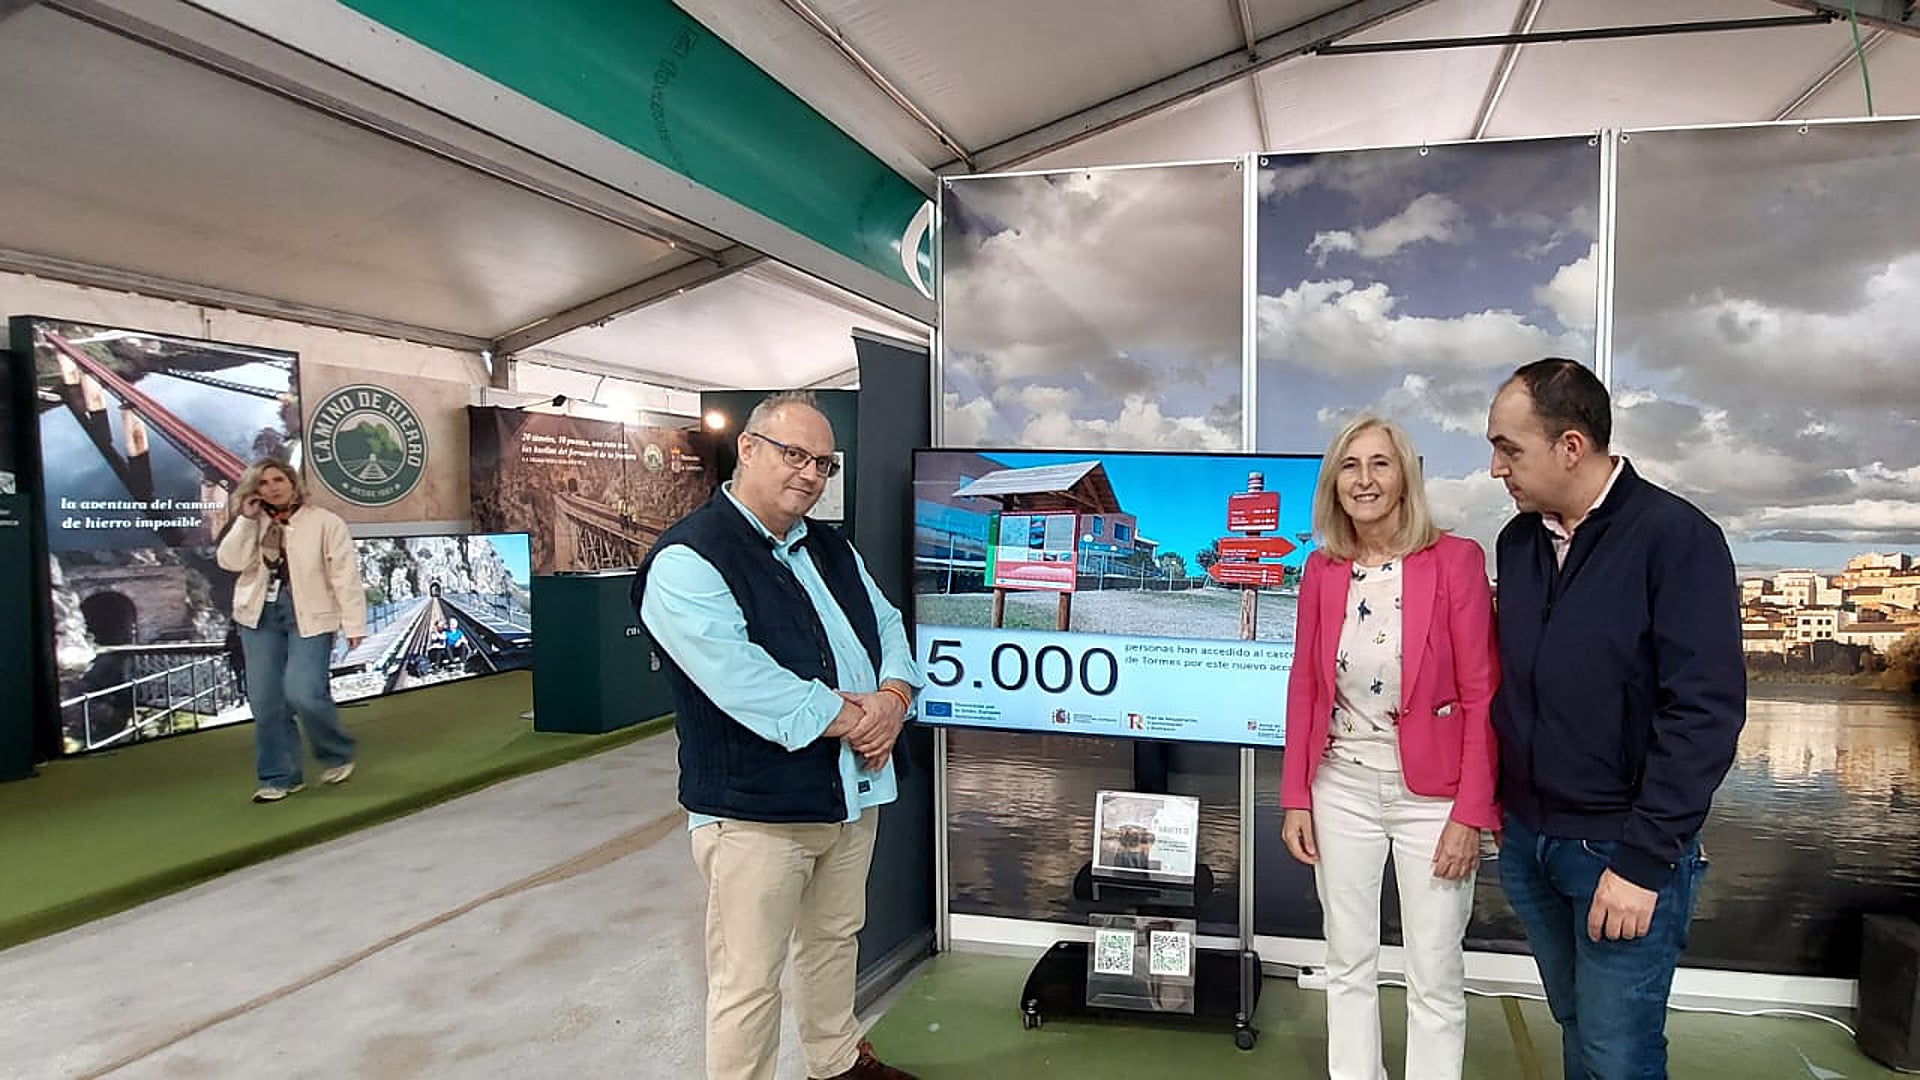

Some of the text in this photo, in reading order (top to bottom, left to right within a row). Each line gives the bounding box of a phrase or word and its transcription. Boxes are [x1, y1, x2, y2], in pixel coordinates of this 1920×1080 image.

[313, 391, 422, 467] CAMINO DE HIERRO
[61, 498, 224, 511] la aventura del camino
[62, 516, 202, 531] de hierro imposible
[1125, 643, 1174, 653] personas
[1177, 645, 1198, 654] han
[1201, 646, 1250, 657] accedido
[1253, 648, 1264, 658] al
[926, 639, 1119, 696] 5.000
[1125, 655, 1139, 664] de
[1142, 656, 1181, 667] Tormes
[1184, 659, 1204, 668] por
[1206, 660, 1229, 669] este
[1232, 661, 1267, 671] nuevo
